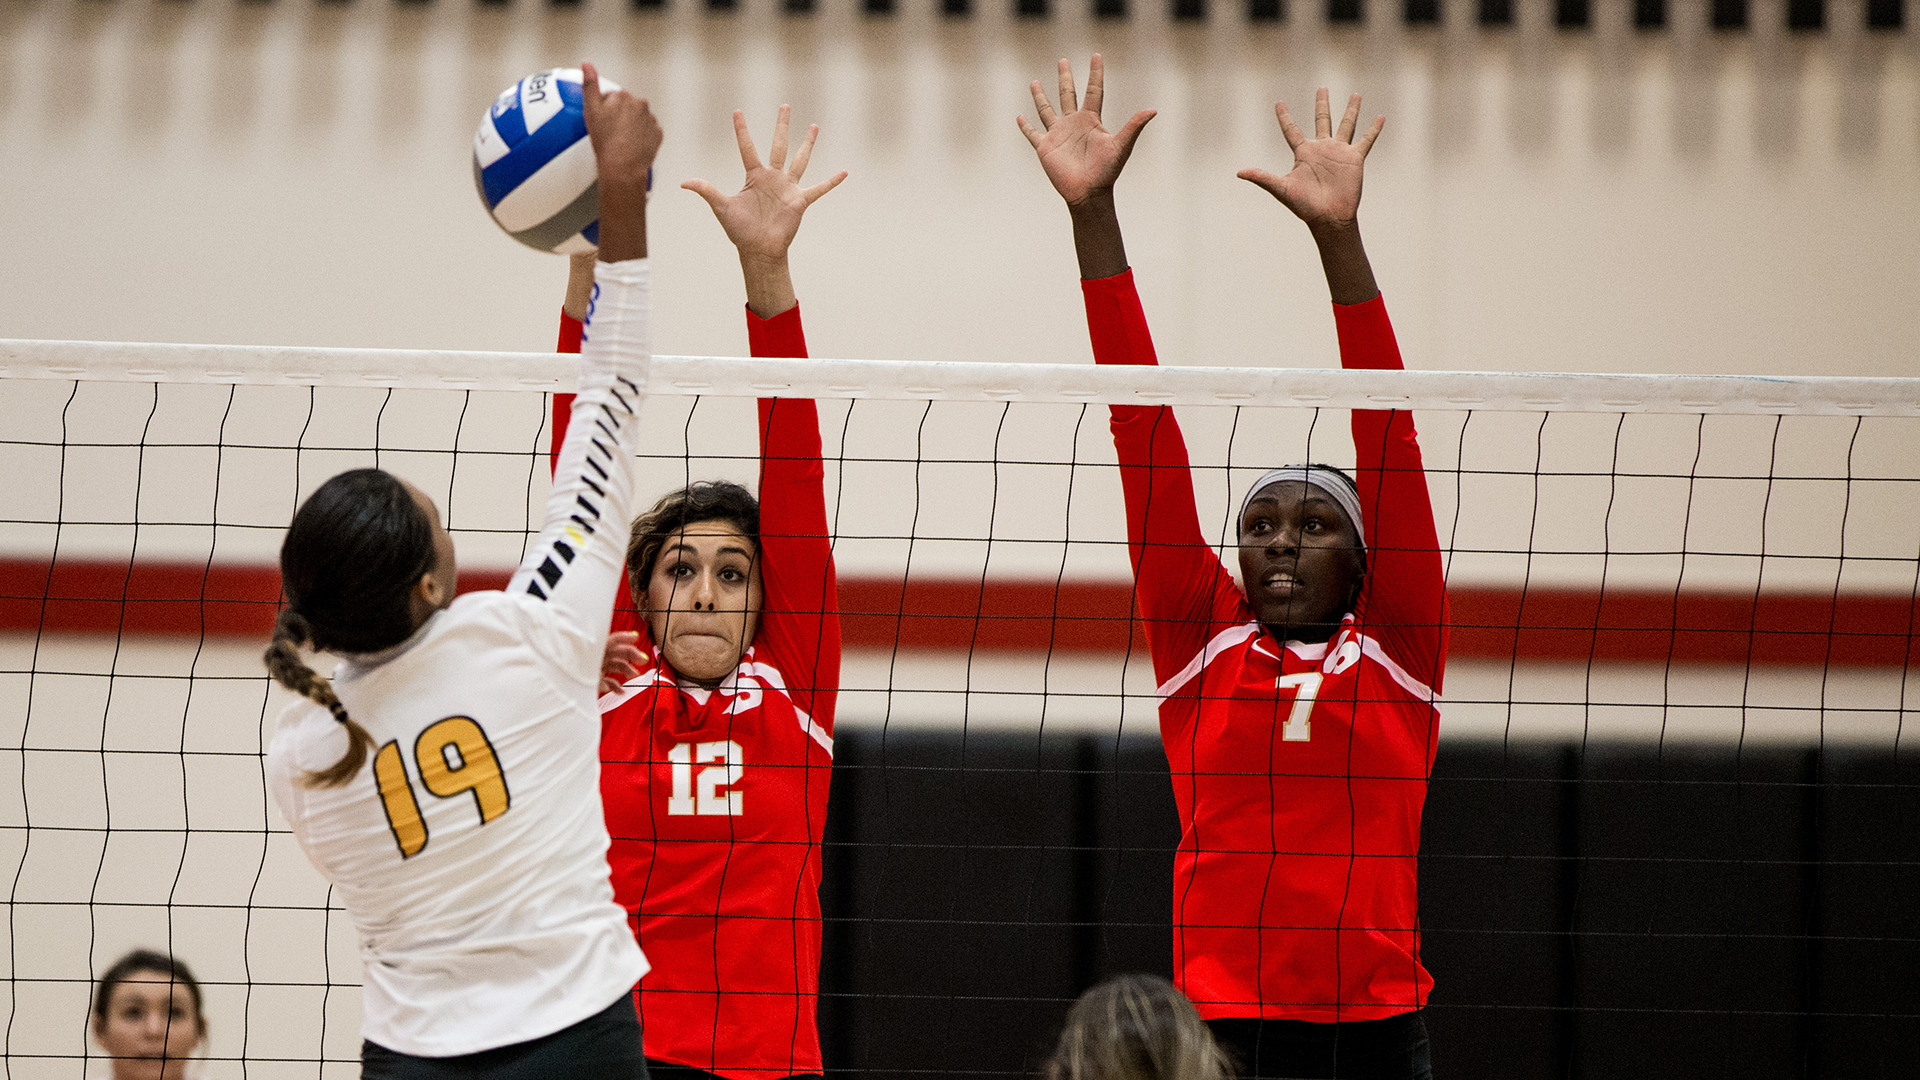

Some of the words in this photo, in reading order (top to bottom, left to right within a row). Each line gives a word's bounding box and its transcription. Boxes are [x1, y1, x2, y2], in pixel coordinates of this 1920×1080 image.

[1275, 672, 1324, 742] 7
[372, 715, 511, 860] 19
[667, 740, 743, 816] 12
